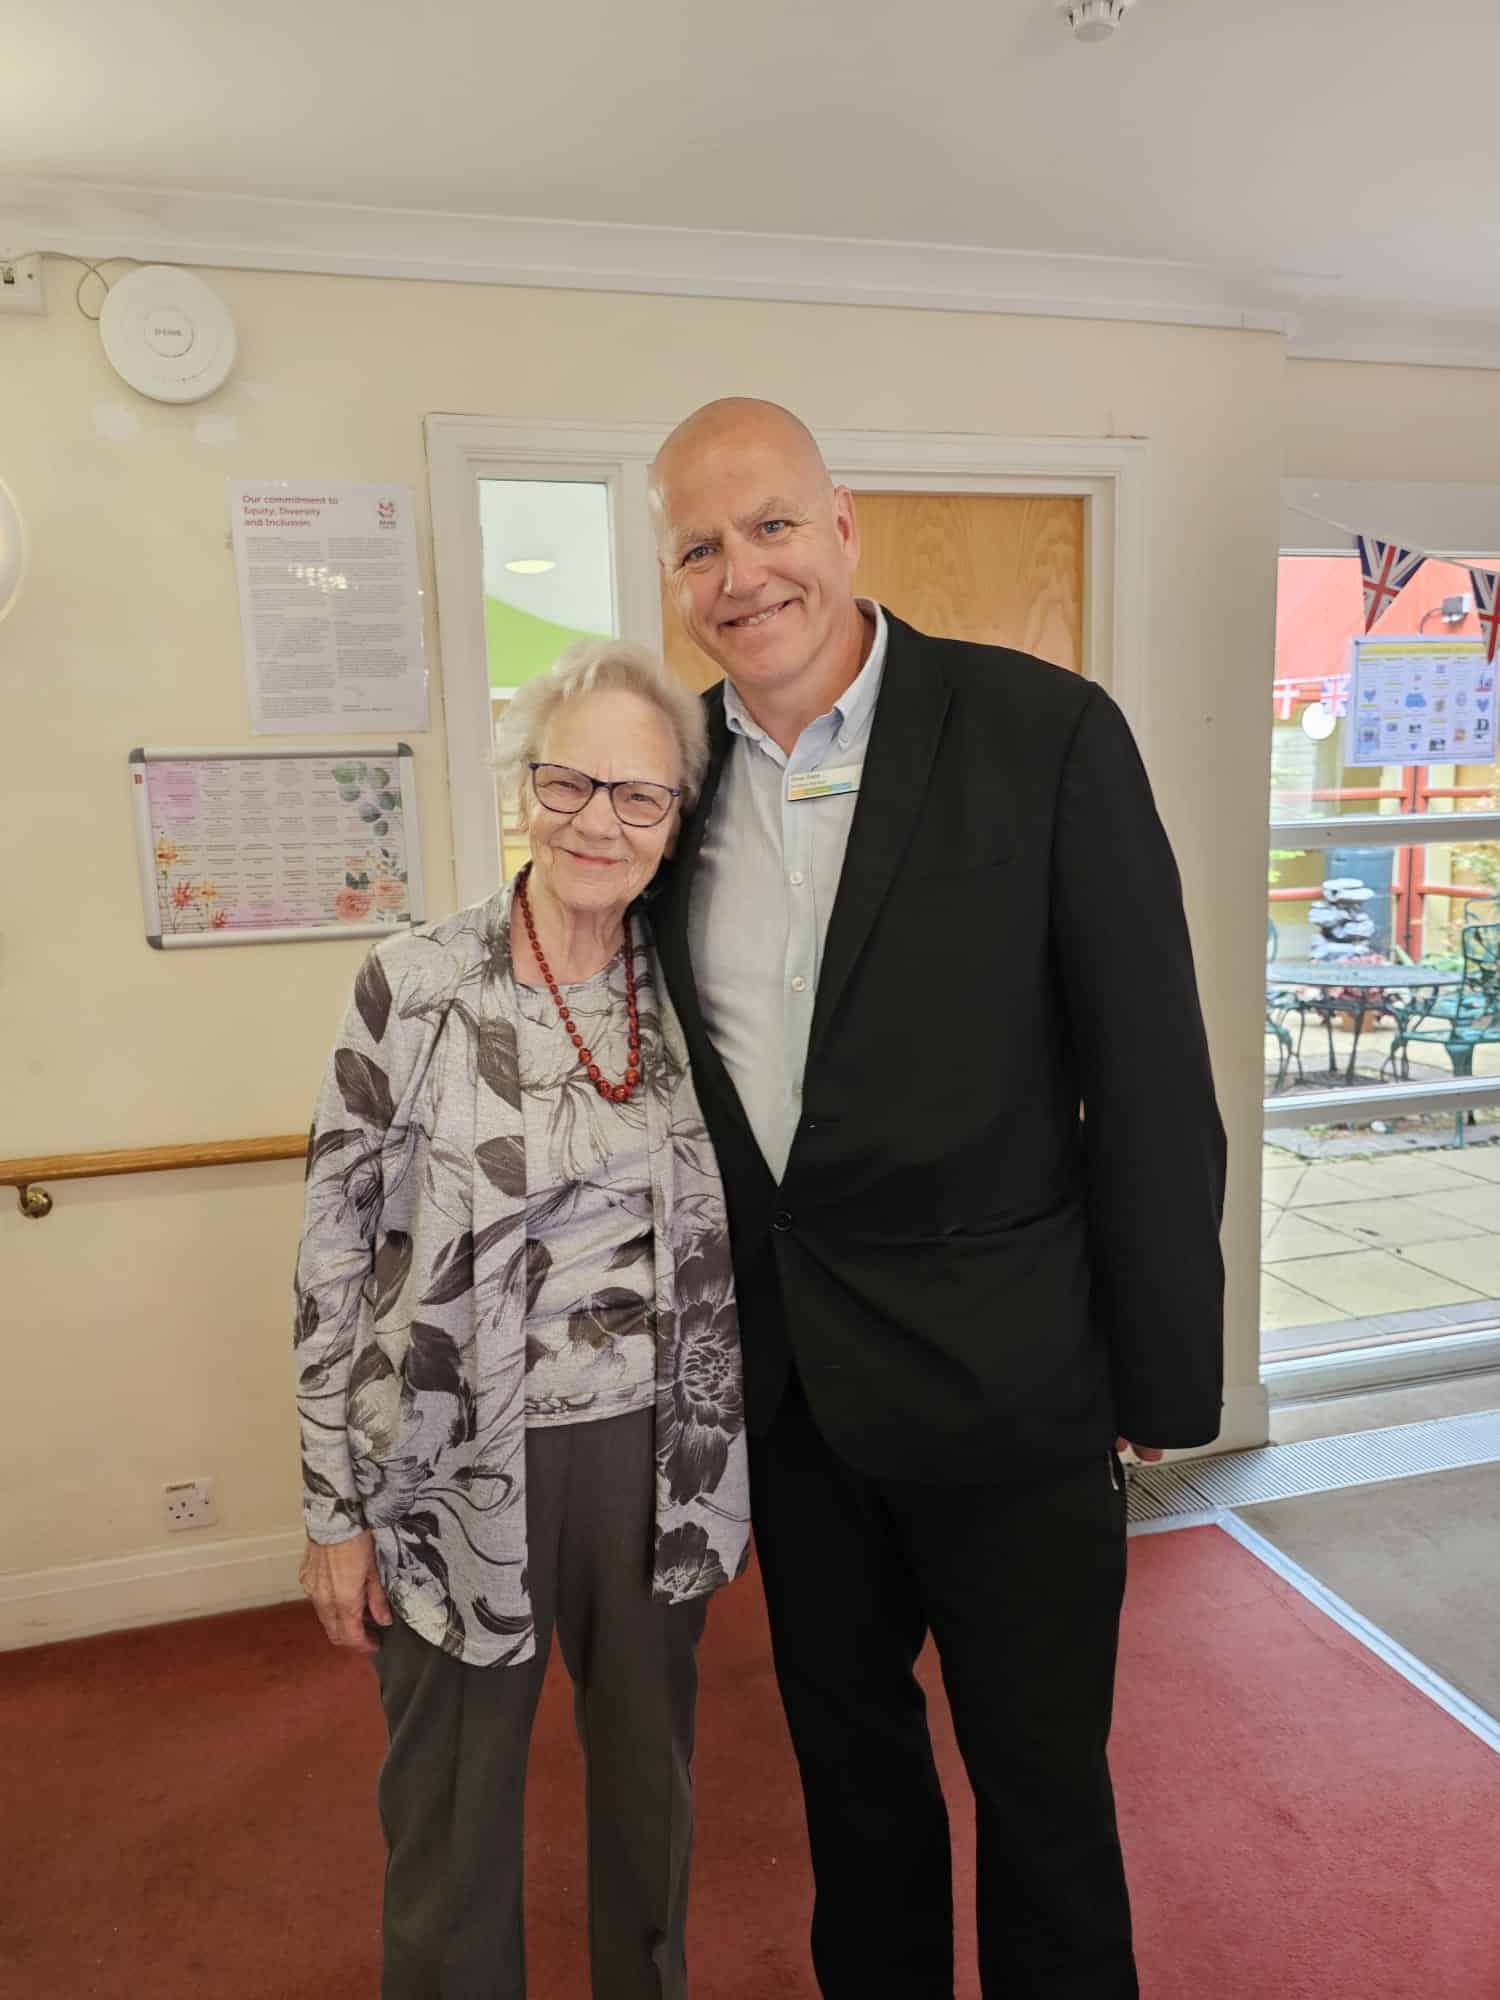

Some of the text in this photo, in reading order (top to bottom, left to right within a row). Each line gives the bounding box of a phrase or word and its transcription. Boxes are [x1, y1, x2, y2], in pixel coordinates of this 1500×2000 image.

[242, 495, 339, 505] Our commitment to
[279, 507, 320, 517] Diversity
[245, 518, 312, 528] and Inclusion
